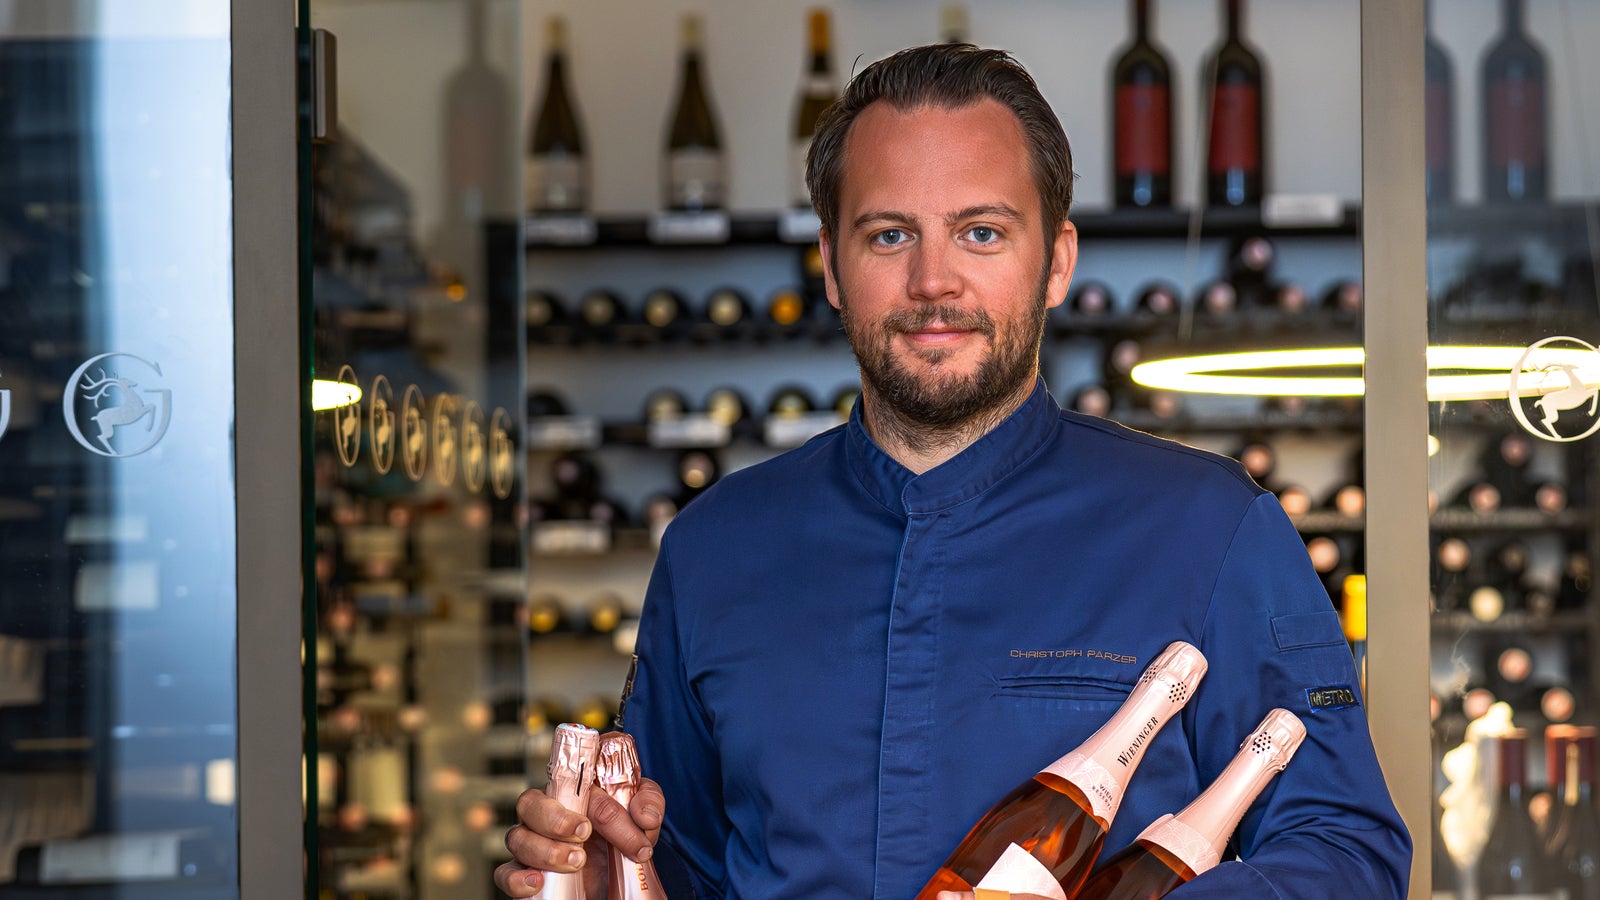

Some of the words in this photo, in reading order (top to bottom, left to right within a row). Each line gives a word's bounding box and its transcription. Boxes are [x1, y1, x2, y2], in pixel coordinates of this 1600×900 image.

[1009, 649, 1083, 659] CHRISTOPH
[1086, 649, 1137, 664] PARZER
[1309, 688, 1355, 707] METRO
